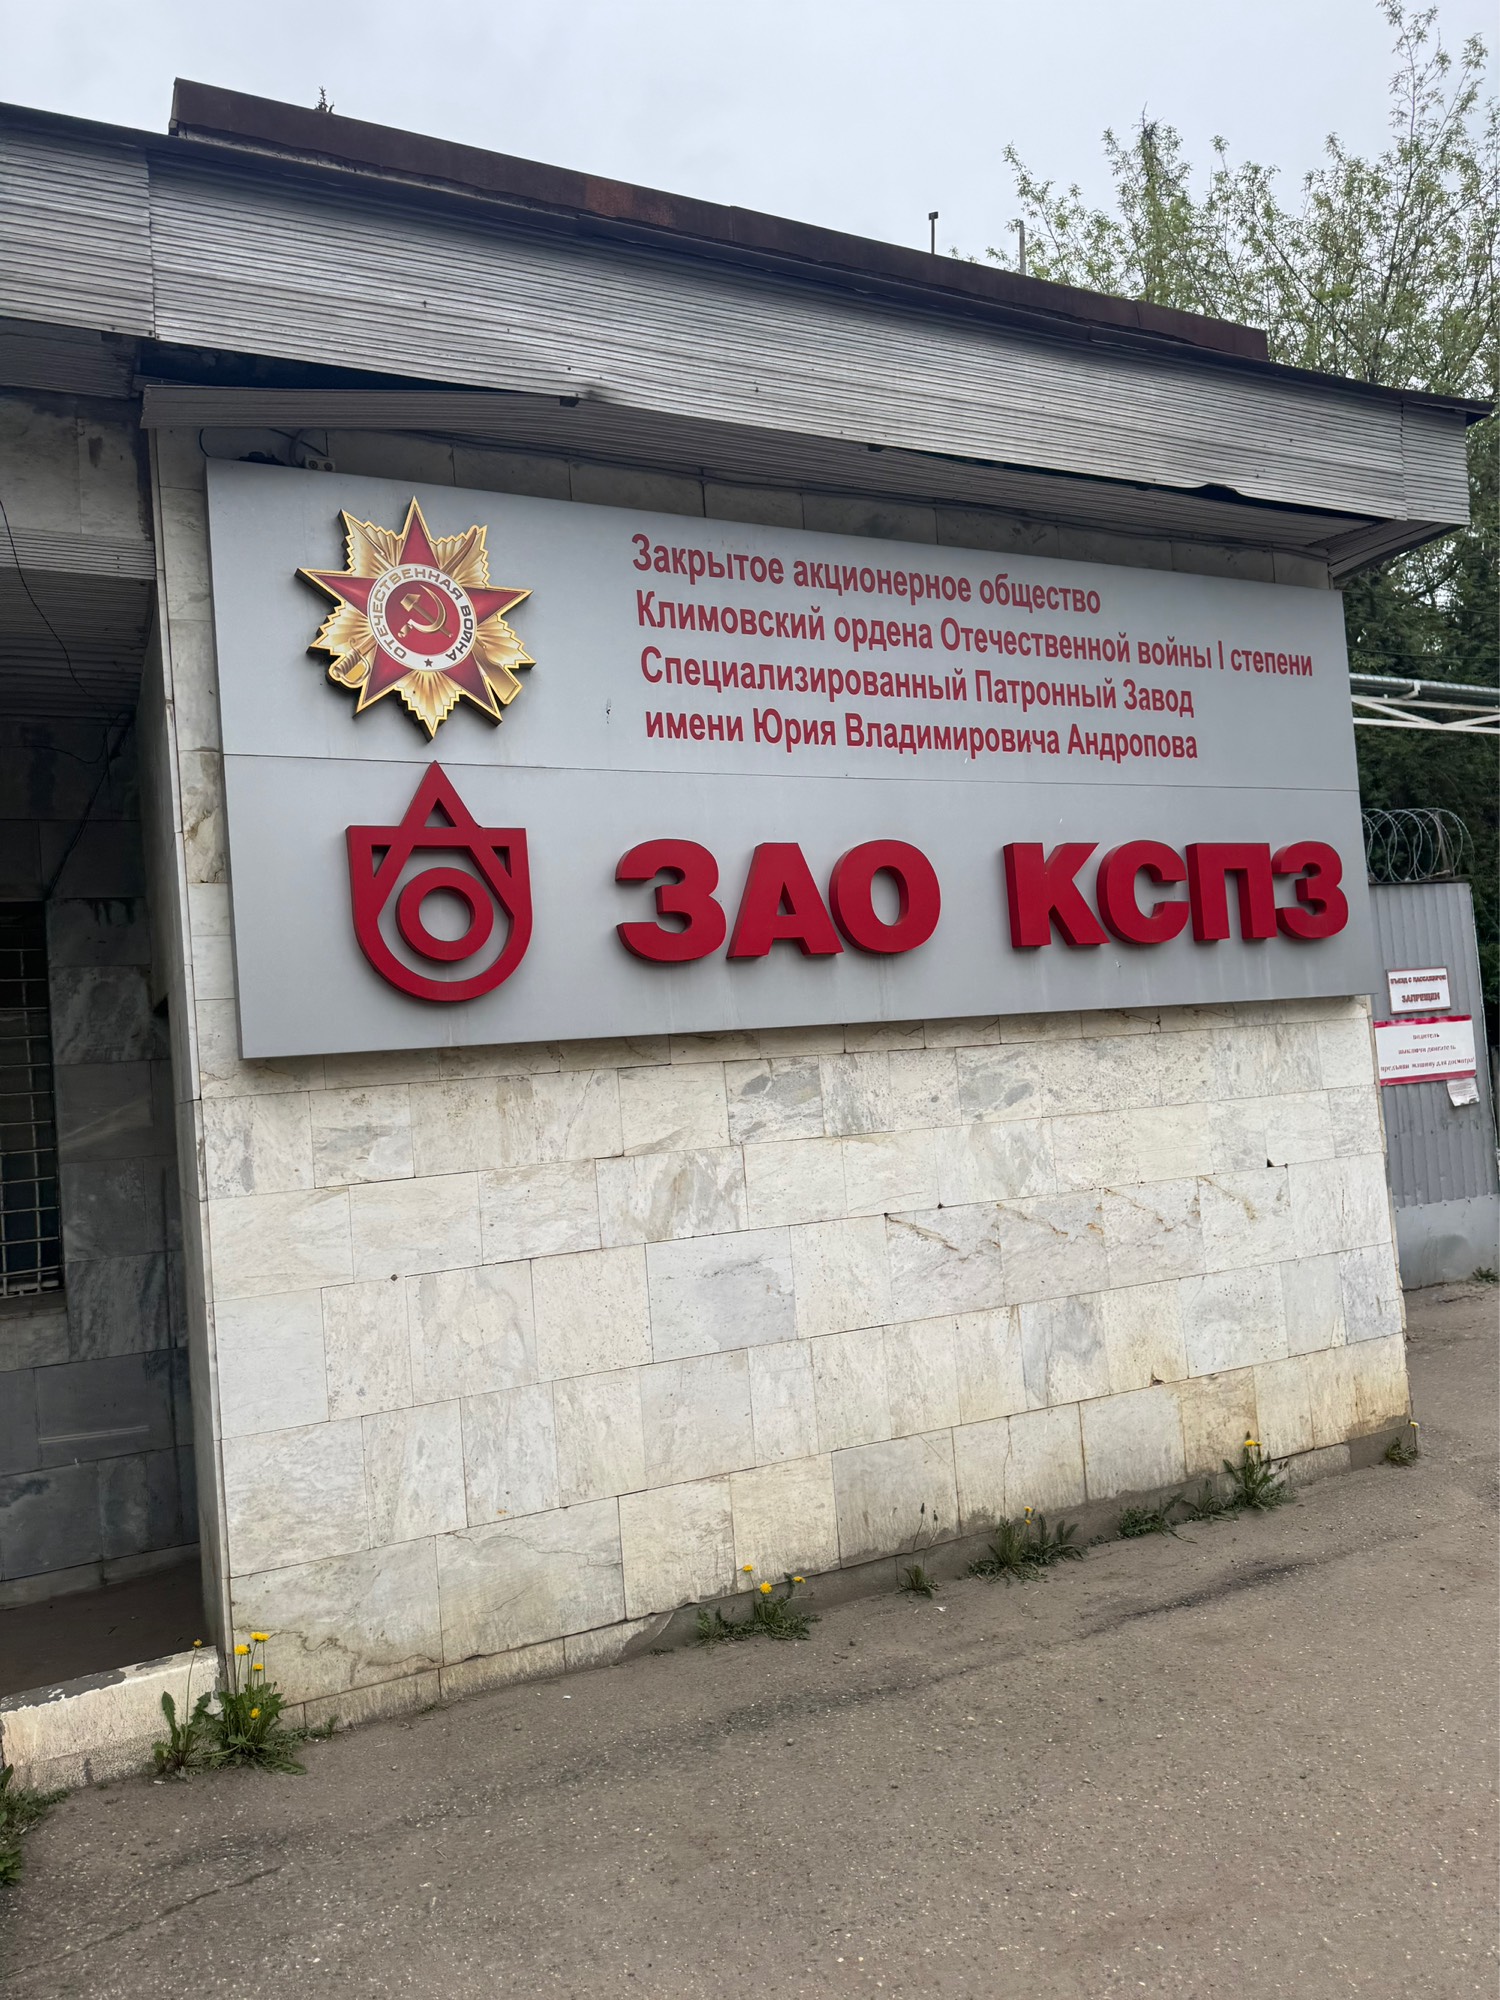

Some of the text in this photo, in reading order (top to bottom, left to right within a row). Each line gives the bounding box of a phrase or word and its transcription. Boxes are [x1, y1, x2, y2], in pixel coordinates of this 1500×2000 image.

[373, 568, 464, 660] ОТЕЧЕСТВЕННАЯ
[634, 534, 1100, 614] Закрытое акционерное общество
[638, 591, 825, 641] Климовский
[834, 616, 933, 651] ордена
[941, 617, 1130, 663] Отечественной
[1138, 637, 1211, 669] войны
[1230, 649, 1313, 676] степени
[642, 645, 1194, 718] Специализированный Патронный Завод
[646, 708, 1198, 765] имени Юрия Владимировича Андропова
[616, 839, 1349, 963] ЗАО КСПЗ
[1401, 992, 1440, 1003] ЗАПРЕЩЕН
